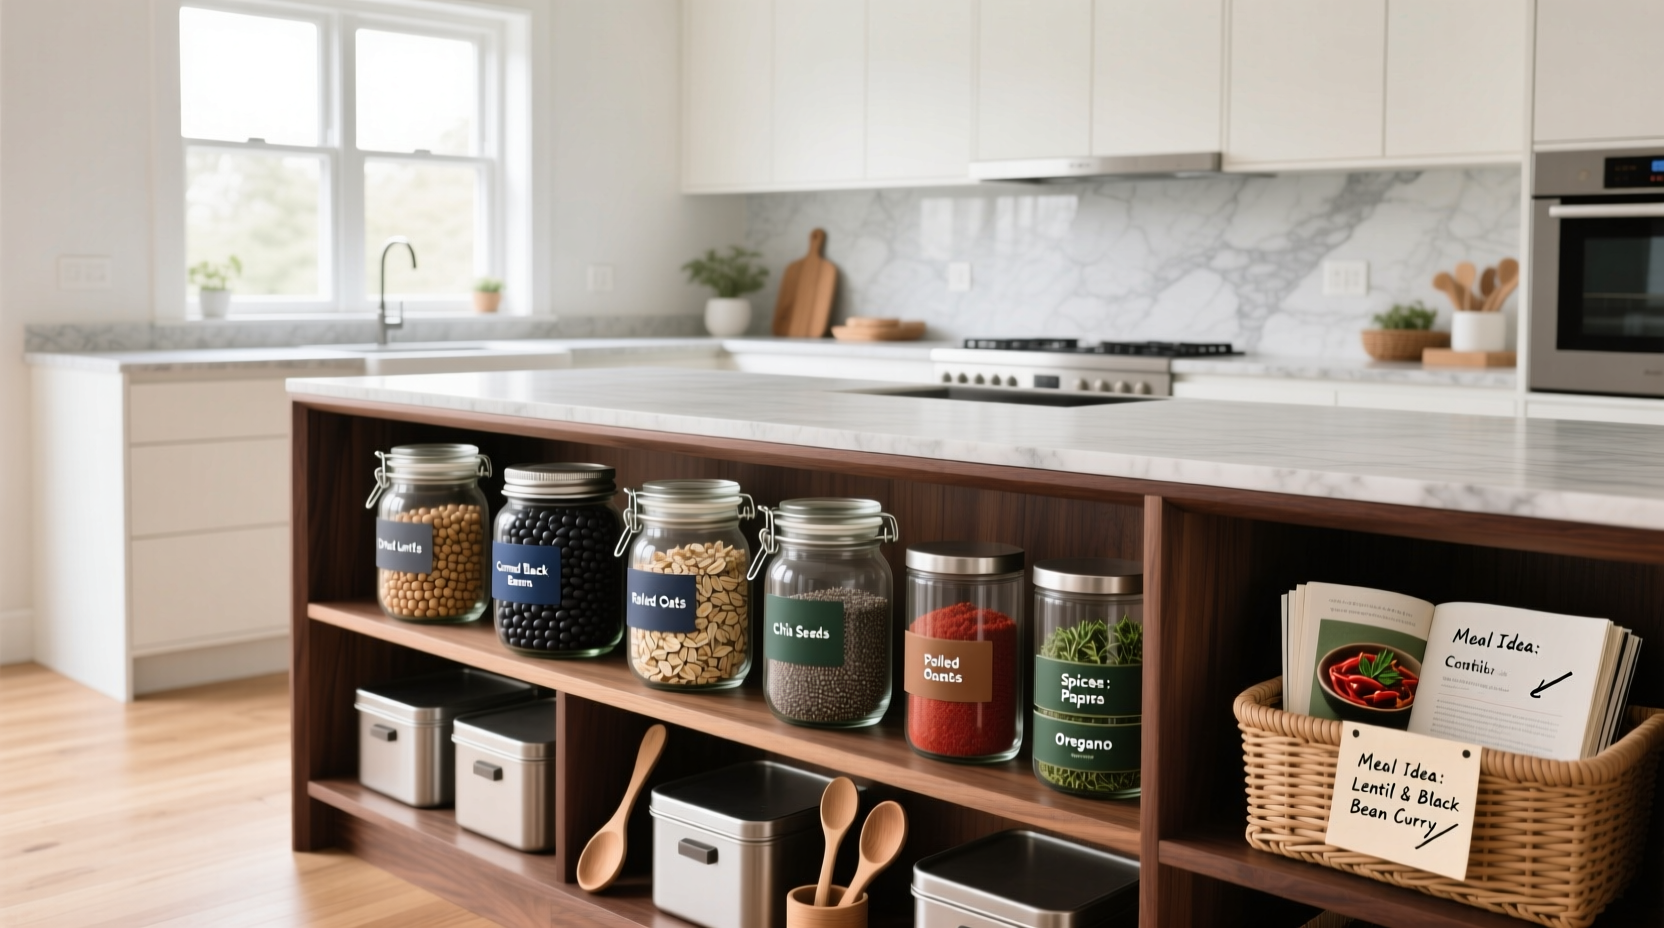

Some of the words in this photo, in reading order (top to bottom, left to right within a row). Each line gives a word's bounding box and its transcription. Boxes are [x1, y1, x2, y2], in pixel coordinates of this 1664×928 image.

[795, 624, 830, 640] Seeds
[1452, 627, 1494, 648] Meal
[1496, 633, 1540, 655] Idea:
[1055, 732, 1113, 753] Oregano
[1357, 752, 1398, 775] Meal
[1403, 762, 1444, 784] Idea:
[1351, 776, 1396, 799] Lentil
[1400, 785, 1411, 802] &
[1417, 789, 1460, 812] Black
[1349, 798, 1388, 820] Bean
[1393, 807, 1437, 839] Curry
